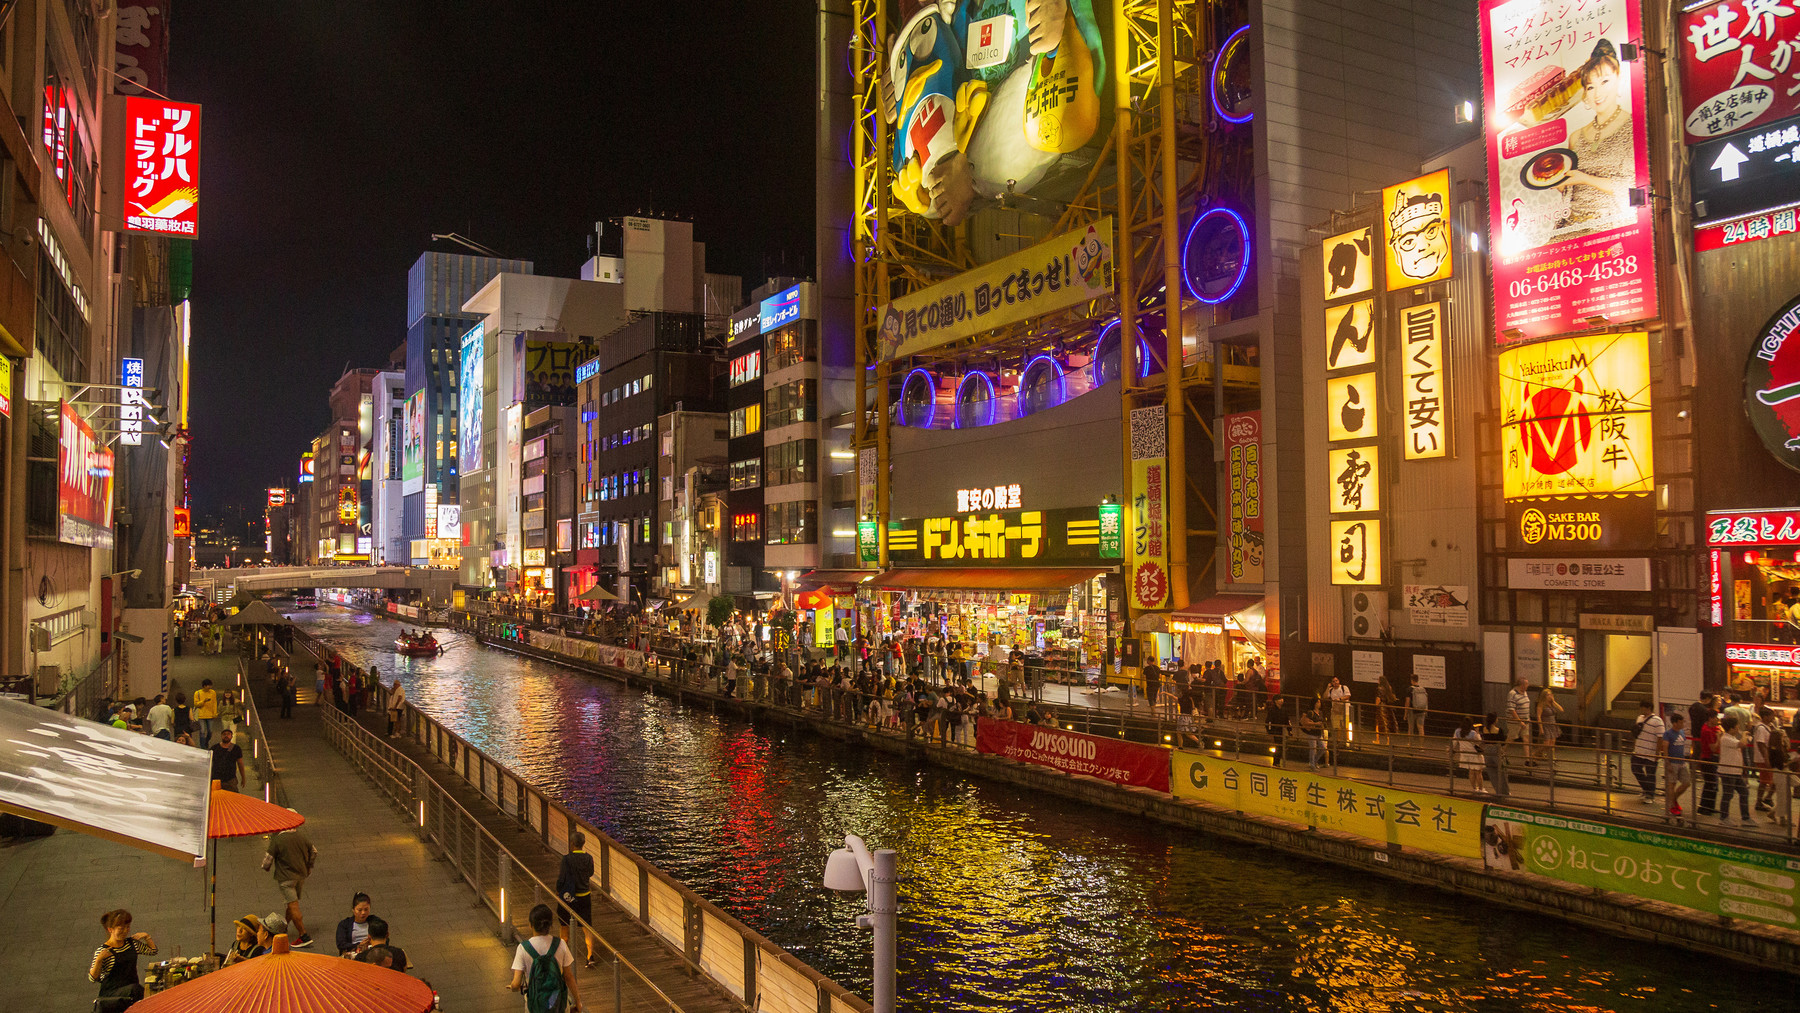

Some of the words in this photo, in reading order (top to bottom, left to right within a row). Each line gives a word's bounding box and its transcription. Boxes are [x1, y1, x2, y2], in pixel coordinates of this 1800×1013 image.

[1505, 22, 1613, 68] マダムブリュレ
[133, 116, 160, 197] ドラッグ
[161, 107, 192, 183] ツルハ
[1723, 209, 1800, 244] 24時間
[1510, 255, 1638, 298] 06-6468-4538
[126, 361, 141, 387] 焼肉
[1407, 308, 1440, 454] 旨くて安い
[1598, 388, 1630, 470] 松阪牛
[1245, 442, 1260, 518] 百年老店
[957, 484, 1021, 512] 驚安の殿堂
[1101, 512, 1118, 534] 薬
[1135, 492, 1148, 556] オープン
[1548, 513, 1575, 523] SAKE
[1577, 512, 1600, 522] BAR
[1548, 524, 1602, 540] M300
[1140, 568, 1160, 586] すぐ
[1140, 586, 1160, 602] そこ
[1726, 648, 1791, 662] お土産販売所
[1030, 730, 1097, 760] JOYSOUND
[1189, 761, 1208, 789] G
[1222, 766, 1458, 834] 合同衛生株式会社
[1566, 845, 1712, 896] ねこのおてて
